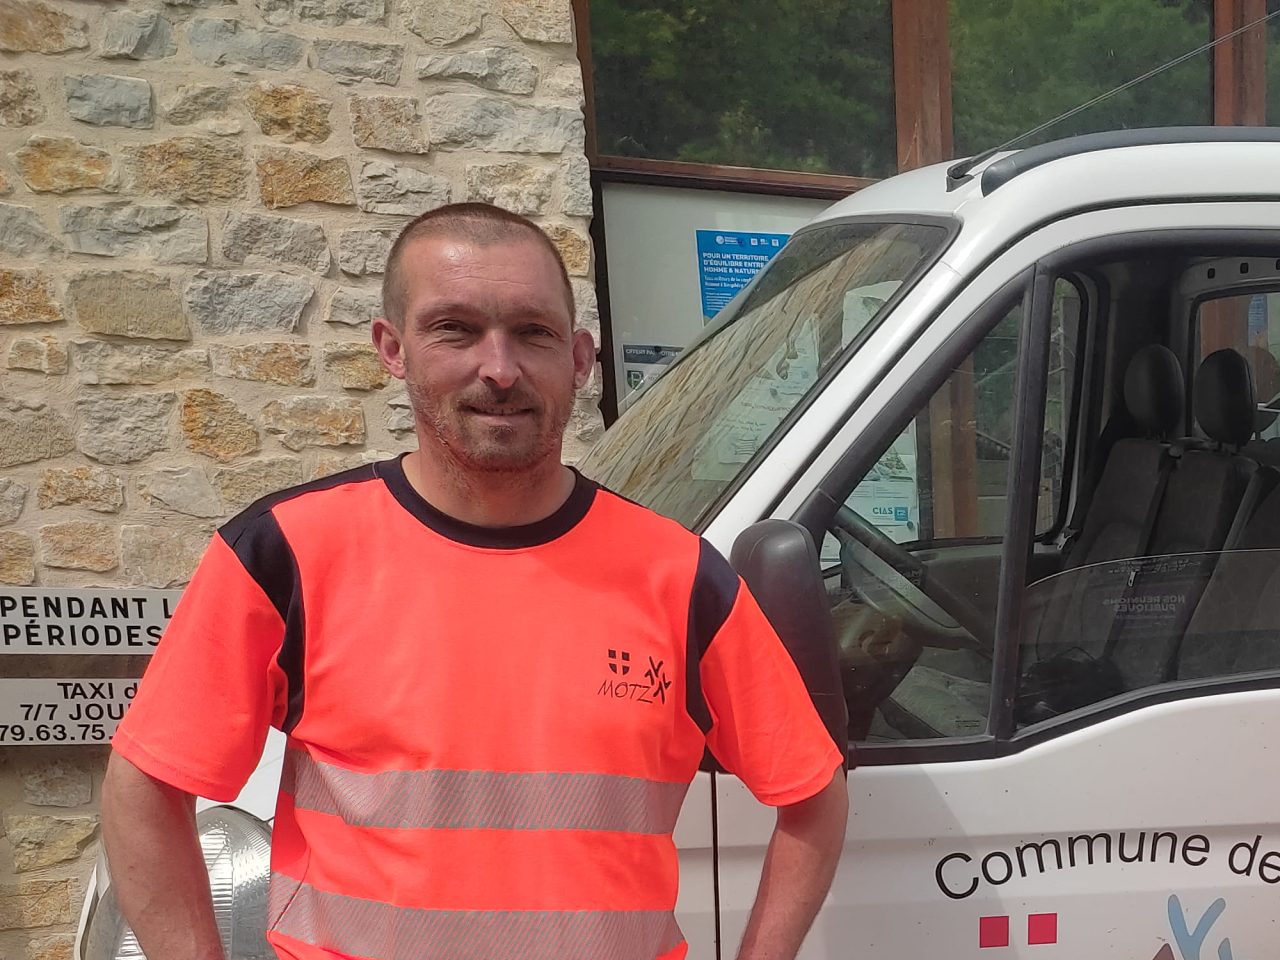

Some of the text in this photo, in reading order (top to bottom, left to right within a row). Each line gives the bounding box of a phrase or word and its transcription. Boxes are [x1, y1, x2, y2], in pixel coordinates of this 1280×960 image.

[731, 254, 769, 262] TERRITOIRE
[872, 507, 893, 515] CIAS
[0, 595, 148, 619] PENDANT
[3, 620, 163, 647] PÉRIODES
[56, 682, 114, 700] TAXI
[597, 680, 653, 704] MOTZ
[20, 703, 131, 721] 7/7 JOU
[0, 724, 120, 741] 79.63.75.
[935, 831, 1211, 900] Commune
